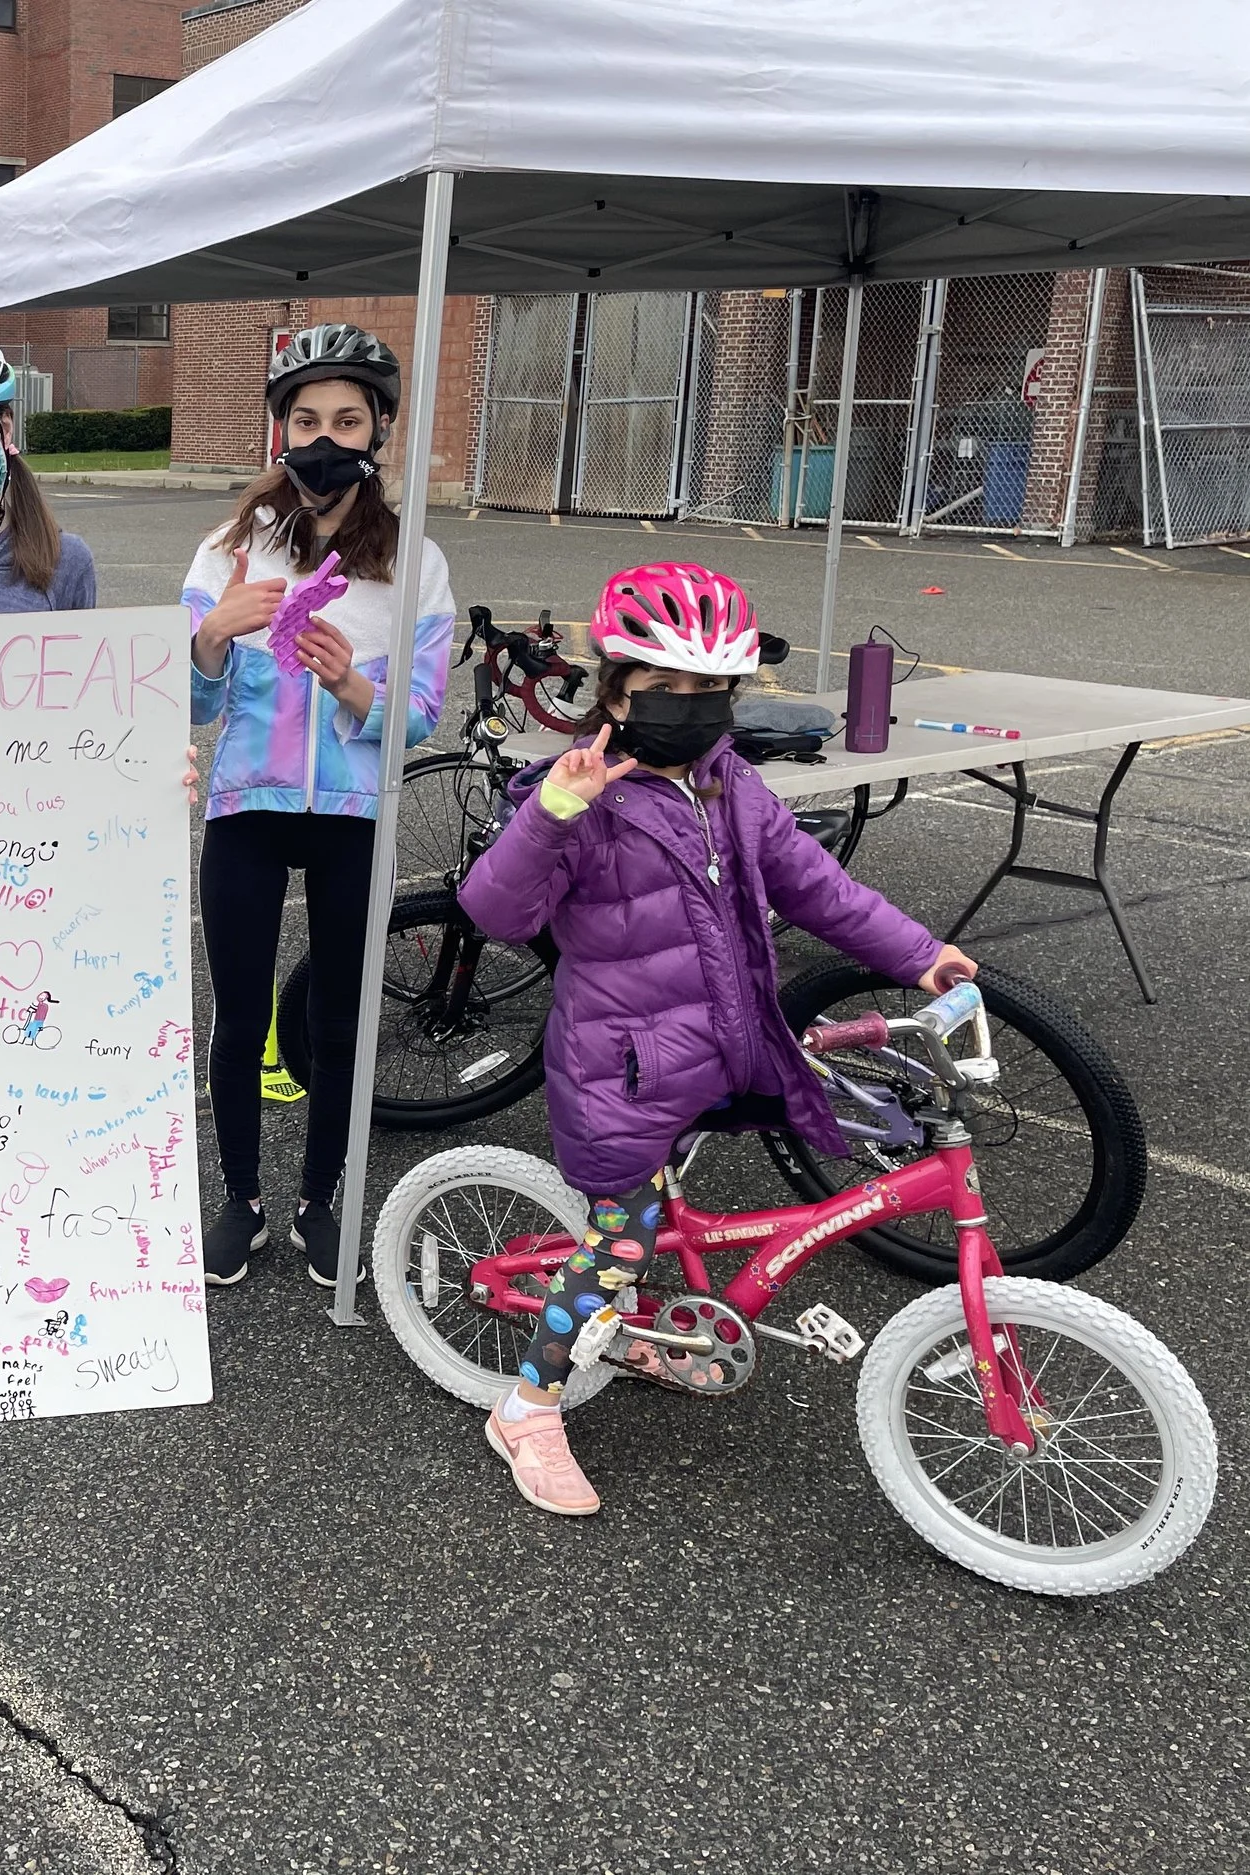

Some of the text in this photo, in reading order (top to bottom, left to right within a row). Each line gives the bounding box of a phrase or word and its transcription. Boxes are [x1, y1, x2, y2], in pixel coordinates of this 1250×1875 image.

[6, 739, 50, 764] me
[85, 1039, 132, 1060] funny
[8, 1084, 23, 1098] to
[36, 1084, 79, 1107] laugh
[126, 1105, 148, 1121] me
[427, 1172, 492, 1189] SCRAMBLER
[724, 1223, 775, 1241] STARDUST
[765, 1194, 885, 1279] SCHWINN
[1140, 1476, 1183, 1550] SCRAMBLER
